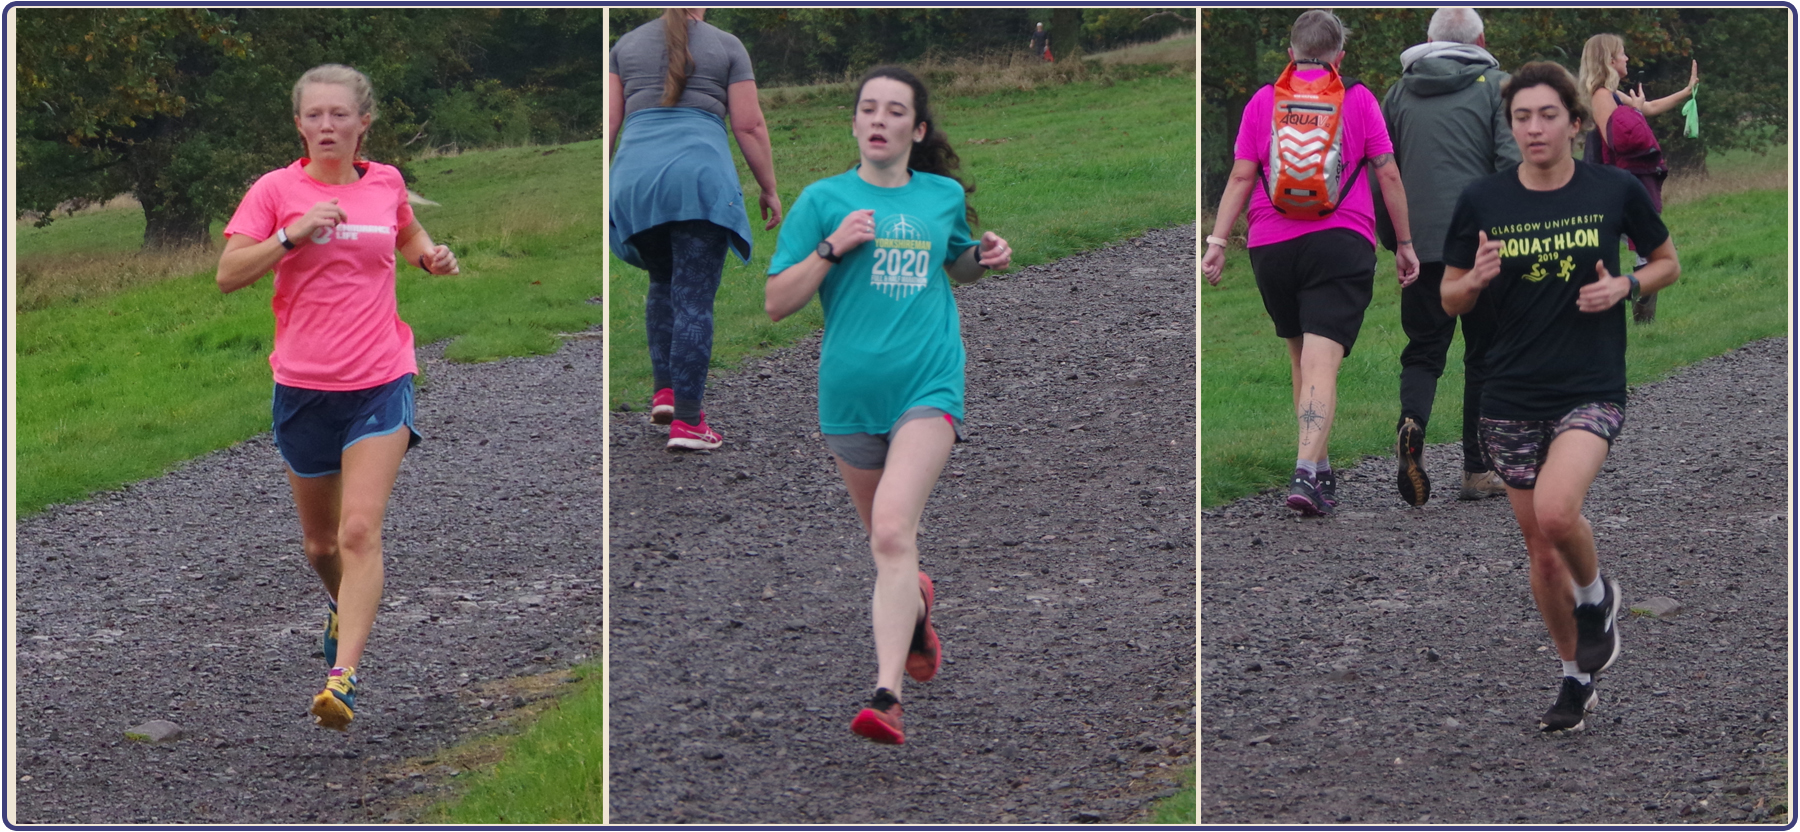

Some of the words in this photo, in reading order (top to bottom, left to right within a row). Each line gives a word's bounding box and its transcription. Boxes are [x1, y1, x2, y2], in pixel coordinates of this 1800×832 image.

[1491, 222, 1541, 236] GLASGOW
[1544, 214, 1604, 230] UNIVERSITY
[336, 232, 358, 240] LIFE
[875, 238, 931, 250] YORKSHIREMAN
[1499, 228, 1599, 258] AQUATHLON
[872, 248, 930, 277] 2020
[1538, 251, 1559, 263] 2019
